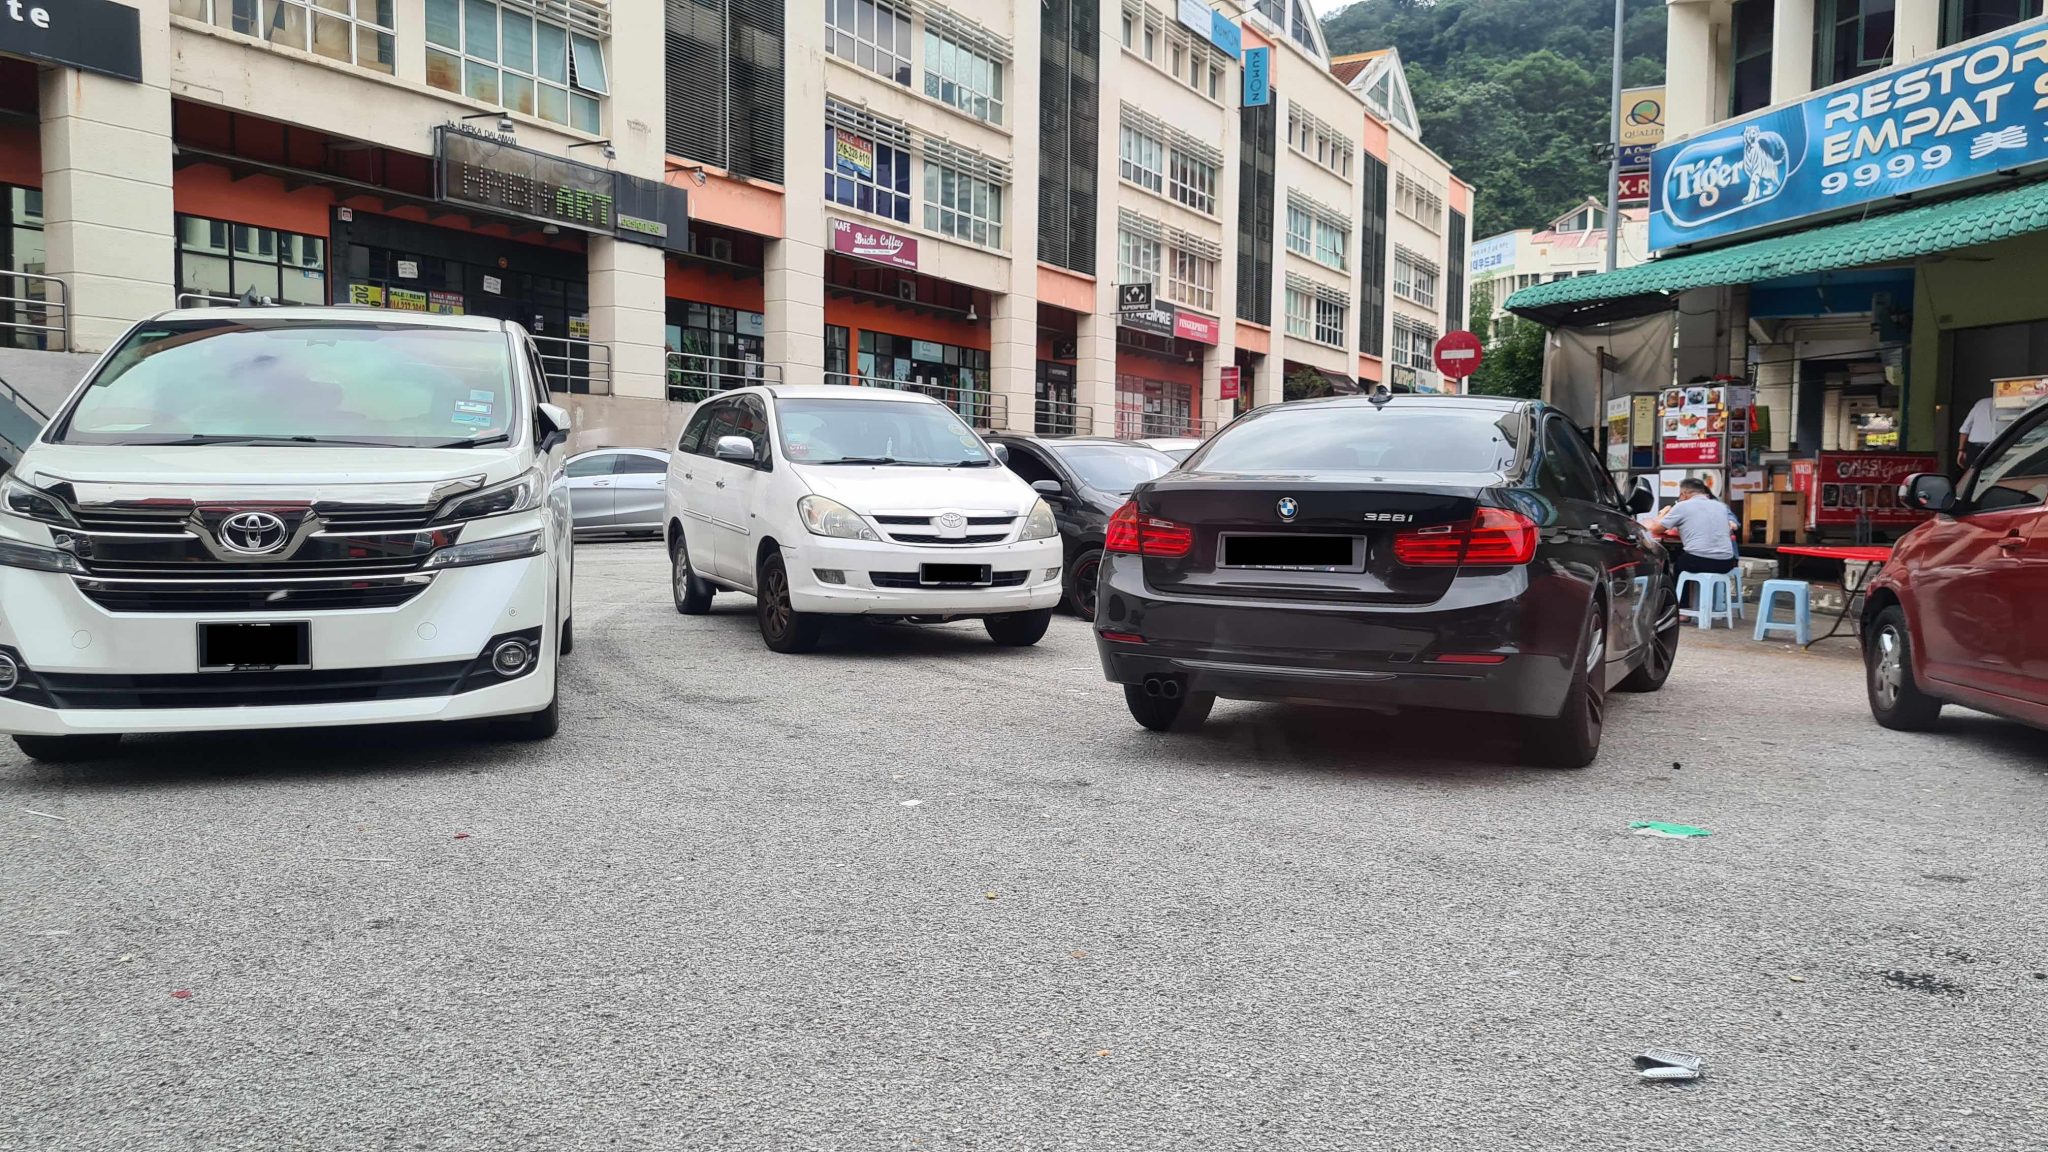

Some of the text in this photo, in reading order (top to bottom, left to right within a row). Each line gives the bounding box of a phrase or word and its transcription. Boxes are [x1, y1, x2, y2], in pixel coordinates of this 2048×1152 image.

[1250, 51, 1262, 101] KUMON
[1822, 82, 2015, 167] EMPAT
[484, 129, 517, 145] DALAMAN
[1672, 154, 1744, 207] Tiger
[835, 220, 851, 233] KAFE
[854, 232, 904, 250] Bricks Coffee
[390, 290, 405, 298] SALE
[409, 292, 425, 300] RENT
